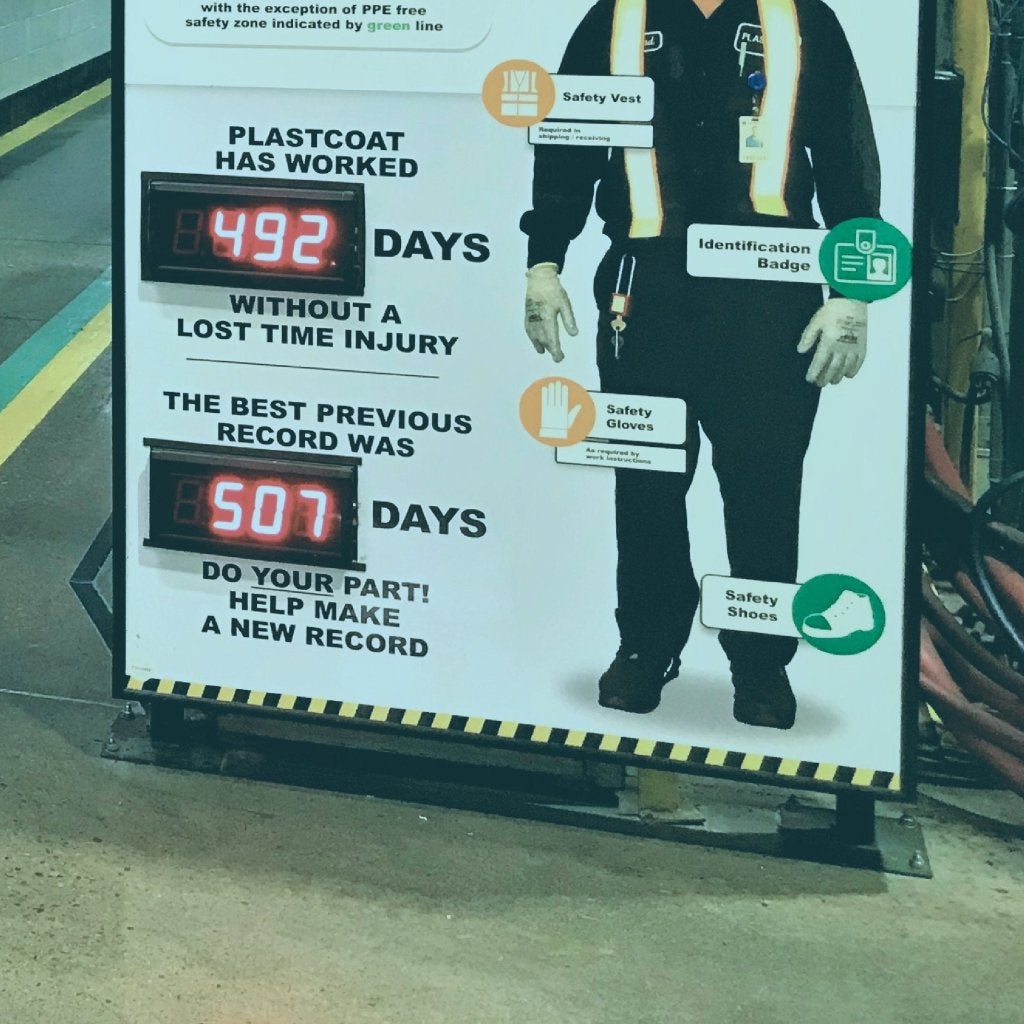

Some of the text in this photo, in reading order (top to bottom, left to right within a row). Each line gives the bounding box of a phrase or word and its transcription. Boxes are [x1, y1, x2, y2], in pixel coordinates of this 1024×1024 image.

[201, 2, 426, 16] with the exception of PPE free
[185, 17, 443, 33] safety zone indicated by green line
[563, 91, 642, 104] Safety Vest
[228, 126, 405, 151] PLASTCOAT
[539, 126, 571, 134] Required
[216, 151, 419, 178] HAS WORKED
[213, 211, 329, 265] 492
[374, 228, 490, 263] DAYS
[699, 238, 811, 254] Identification
[757, 257, 811, 273] Badge
[229, 294, 402, 325] WITHOUT A
[177, 318, 459, 355] LOST TIME INJURY
[163, 391, 473, 434] THE BEST PREVIOUS
[607, 404, 652, 418] Safety
[606, 419, 654, 432] Gloves
[217, 422, 415, 458] RECORD WAS
[597, 448, 629, 456] required
[607, 456, 652, 464] instructions
[213, 482, 327, 538] 507
[372, 500, 487, 538] DAYS
[202, 561, 430, 604] DO YOUR PART!
[229, 591, 400, 628] HELP MAKE
[726, 589, 778, 607] Safety
[728, 606, 778, 621] Shoes
[201, 615, 429, 658] A NEW RECORD
